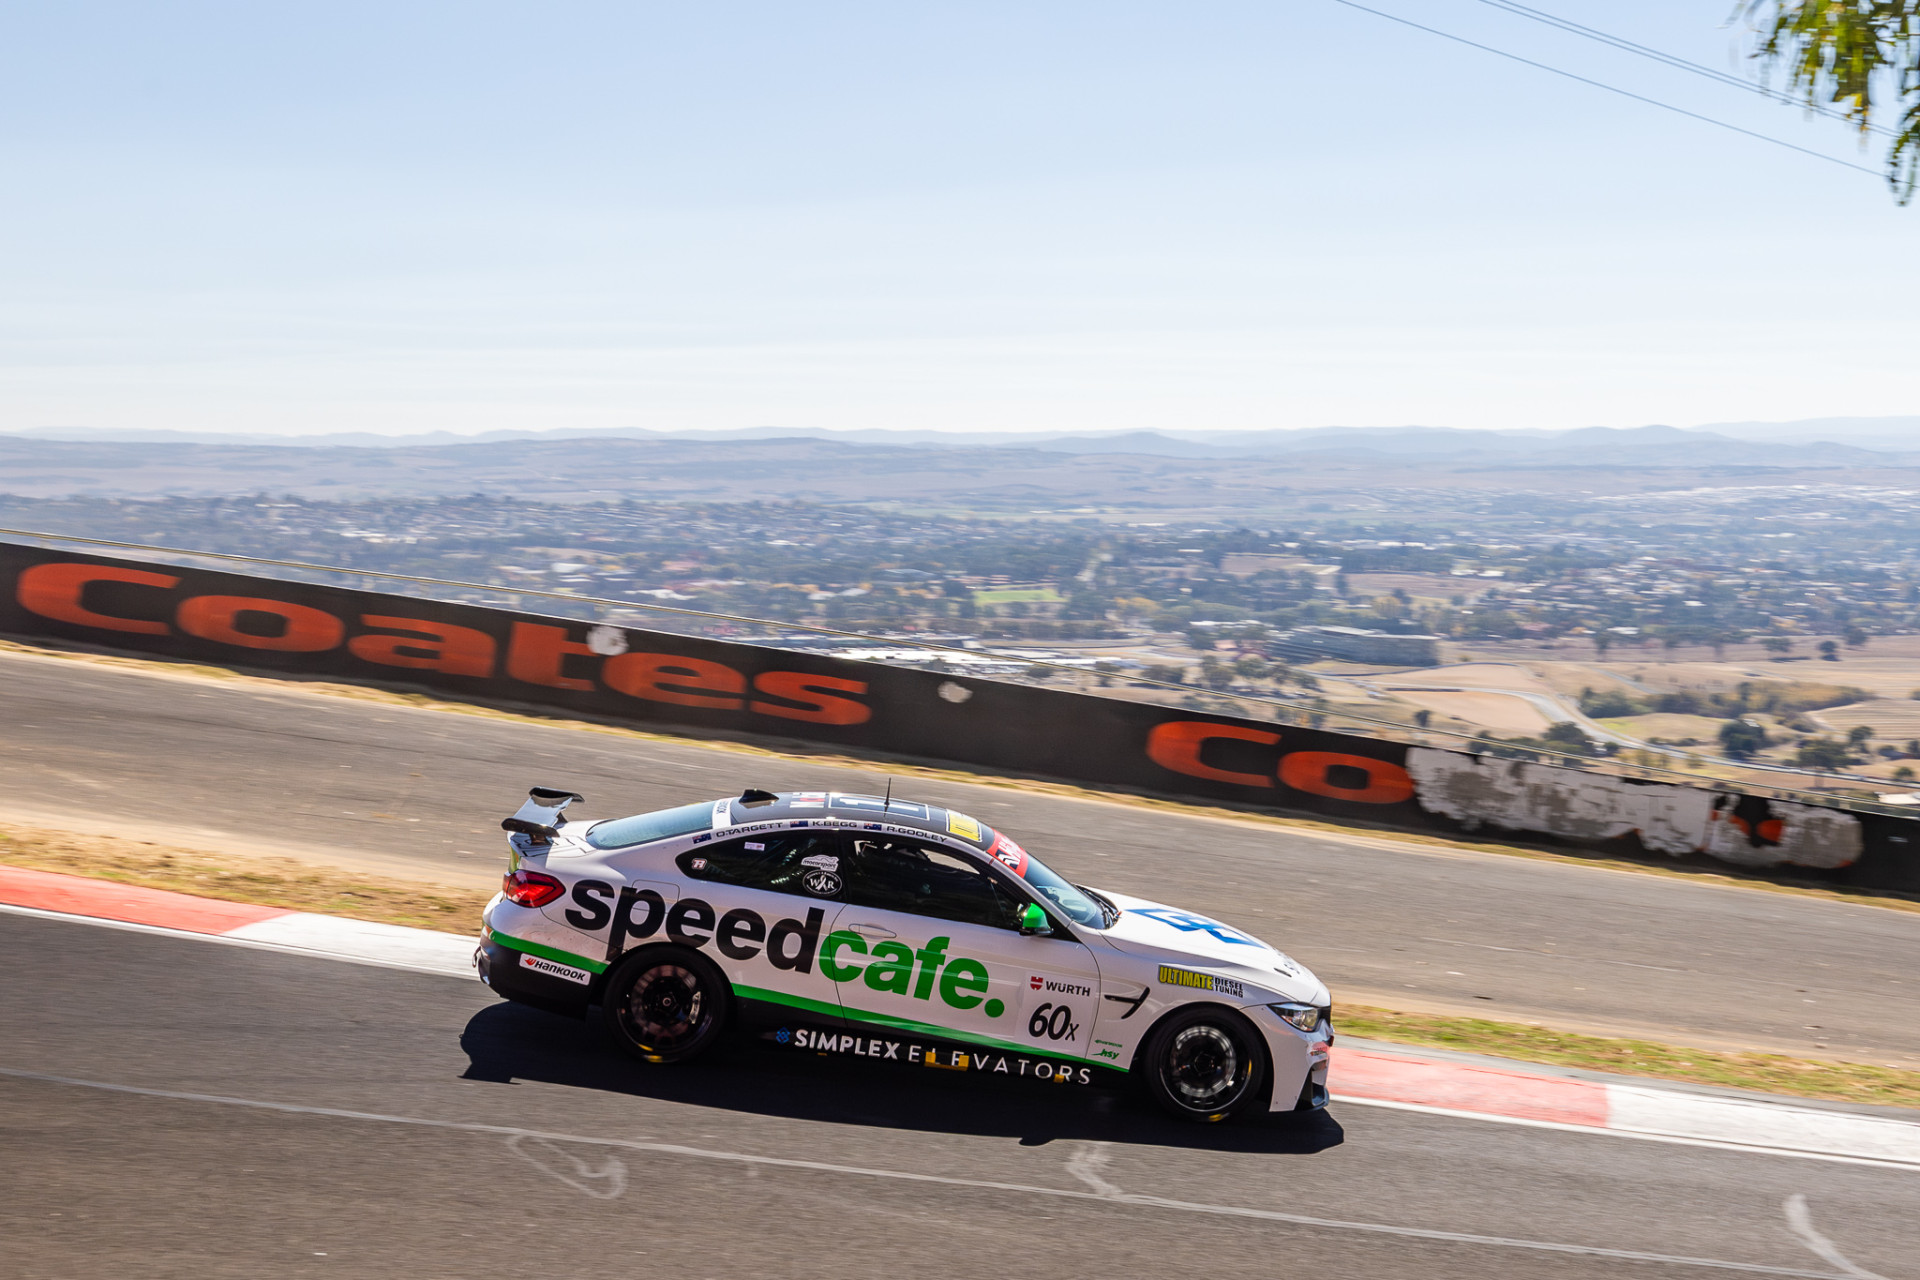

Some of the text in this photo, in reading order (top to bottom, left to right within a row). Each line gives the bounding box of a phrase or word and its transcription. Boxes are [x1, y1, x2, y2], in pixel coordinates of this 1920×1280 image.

[15, 562, 872, 726] Coates
[1159, 965, 1214, 990] ULTIMATE
[1214, 977, 1244, 990] DIESEL
[1214, 984, 1244, 998] TUNING
[794, 1028, 901, 1060] SIMPLEX
